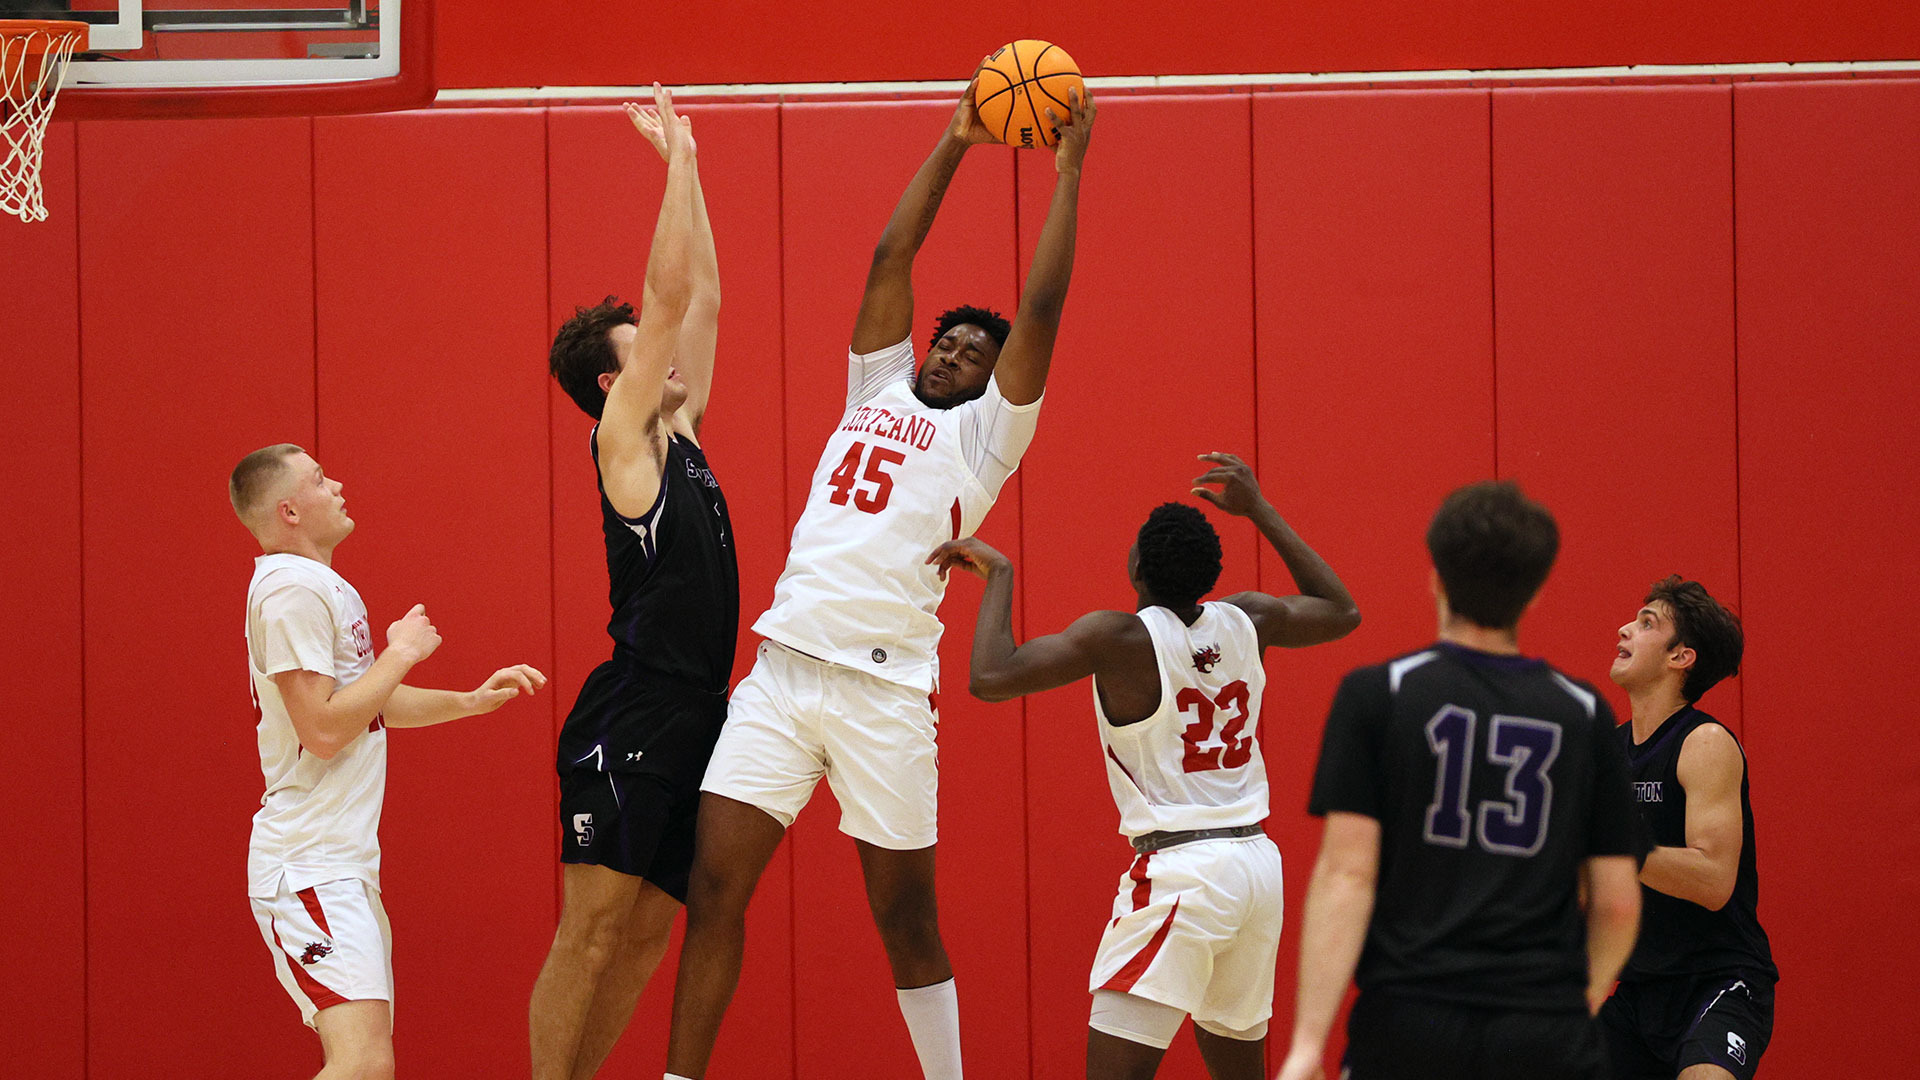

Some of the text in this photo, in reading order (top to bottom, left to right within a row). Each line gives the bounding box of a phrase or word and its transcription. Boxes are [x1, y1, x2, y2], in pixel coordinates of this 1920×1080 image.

[827, 441, 906, 515] 45
[1176, 679, 1252, 774] 22
[1423, 703, 1562, 858] 13
[1632, 781, 1663, 802] TON
